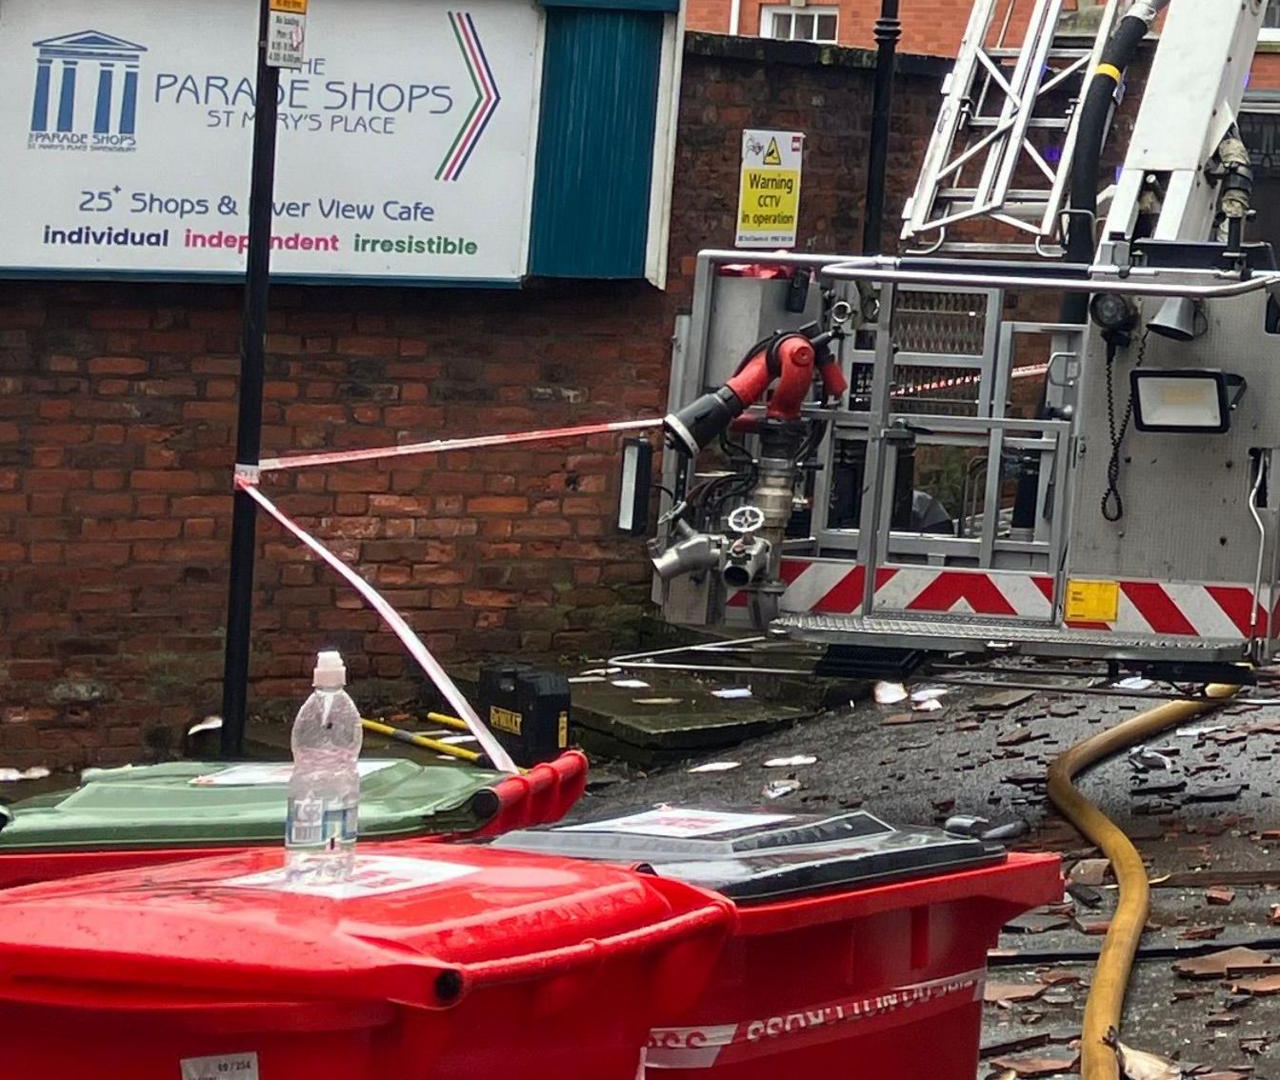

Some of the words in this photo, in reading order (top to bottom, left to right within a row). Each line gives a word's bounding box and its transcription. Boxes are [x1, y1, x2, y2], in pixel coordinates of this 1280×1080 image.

[290, 57, 326, 76] HE
[324, 80, 454, 114] SHOPS
[207, 110, 235, 127] ST
[242, 111, 323, 132] MRY'S
[330, 114, 396, 134] PLACE
[34, 132, 88, 145] PARADE
[92, 133, 136, 146] SHOPS
[748, 173, 793, 194] Warning
[130, 192, 209, 219] Shops
[217, 195, 239, 216] &
[383, 200, 435, 222] Cafe
[757, 195, 782, 208] CCTV
[741, 210, 750, 224] in
[752, 210, 794, 227] operation
[43, 224, 169, 248] individual
[184, 228, 339, 254] indepndent
[353, 233, 479, 256] irresistible
